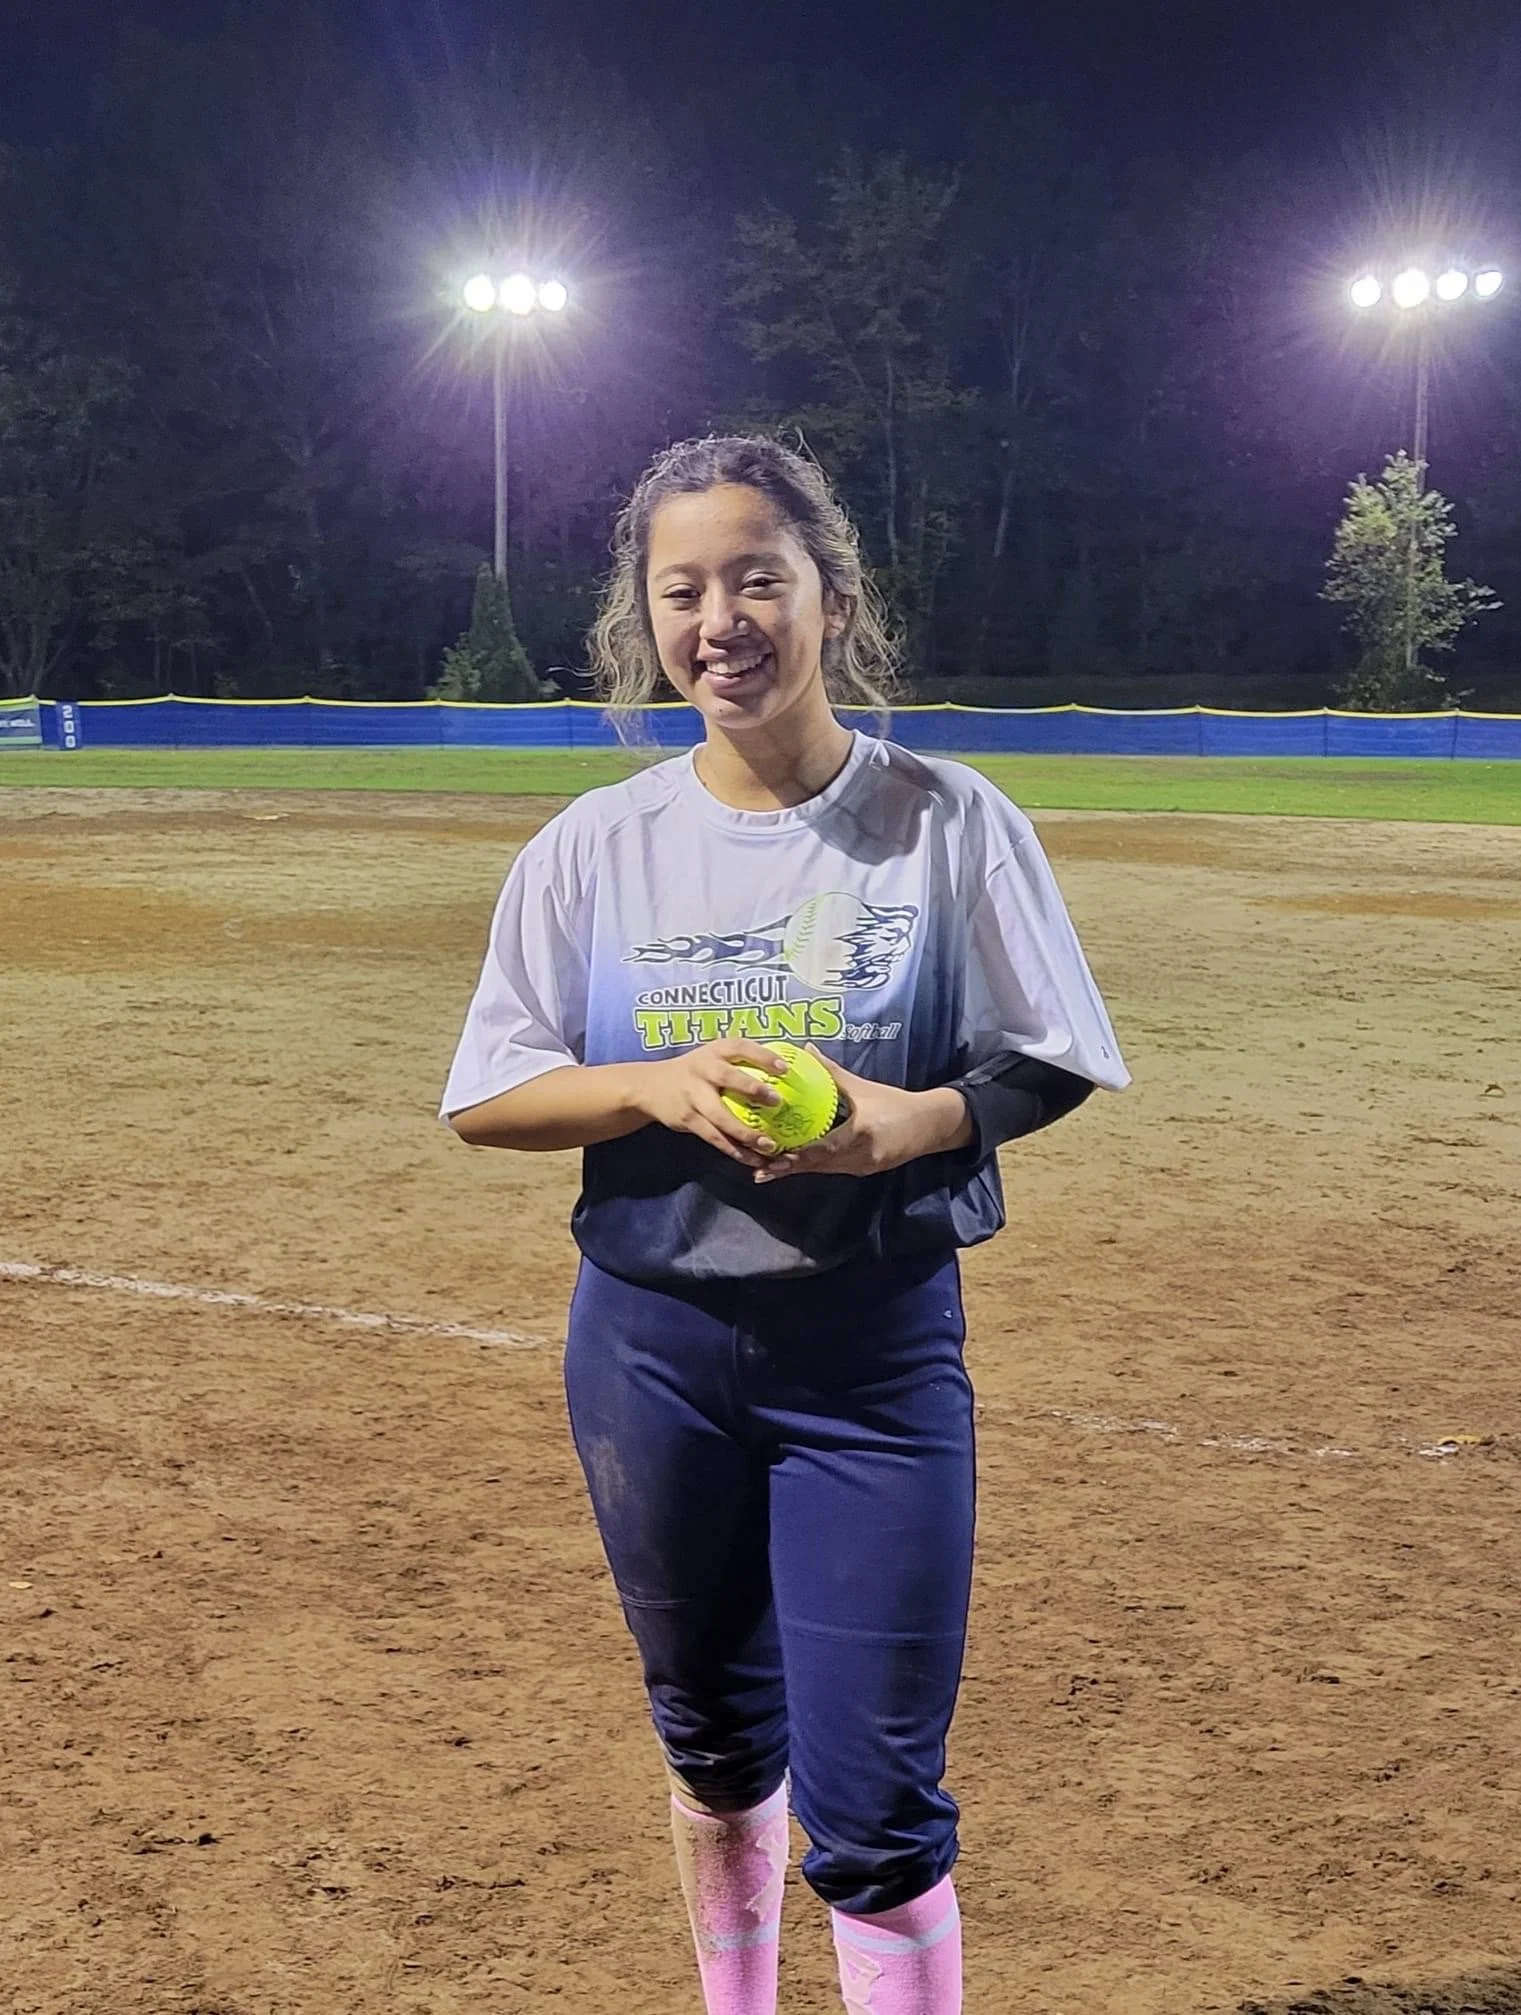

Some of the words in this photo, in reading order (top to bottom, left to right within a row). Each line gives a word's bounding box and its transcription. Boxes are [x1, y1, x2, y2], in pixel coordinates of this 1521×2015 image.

[62, 705, 76, 748] 200
[638, 975, 788, 1005] CONNECTICUT
[635, 998, 843, 1050] TITANS
[842, 1022, 902, 1042] Softball
